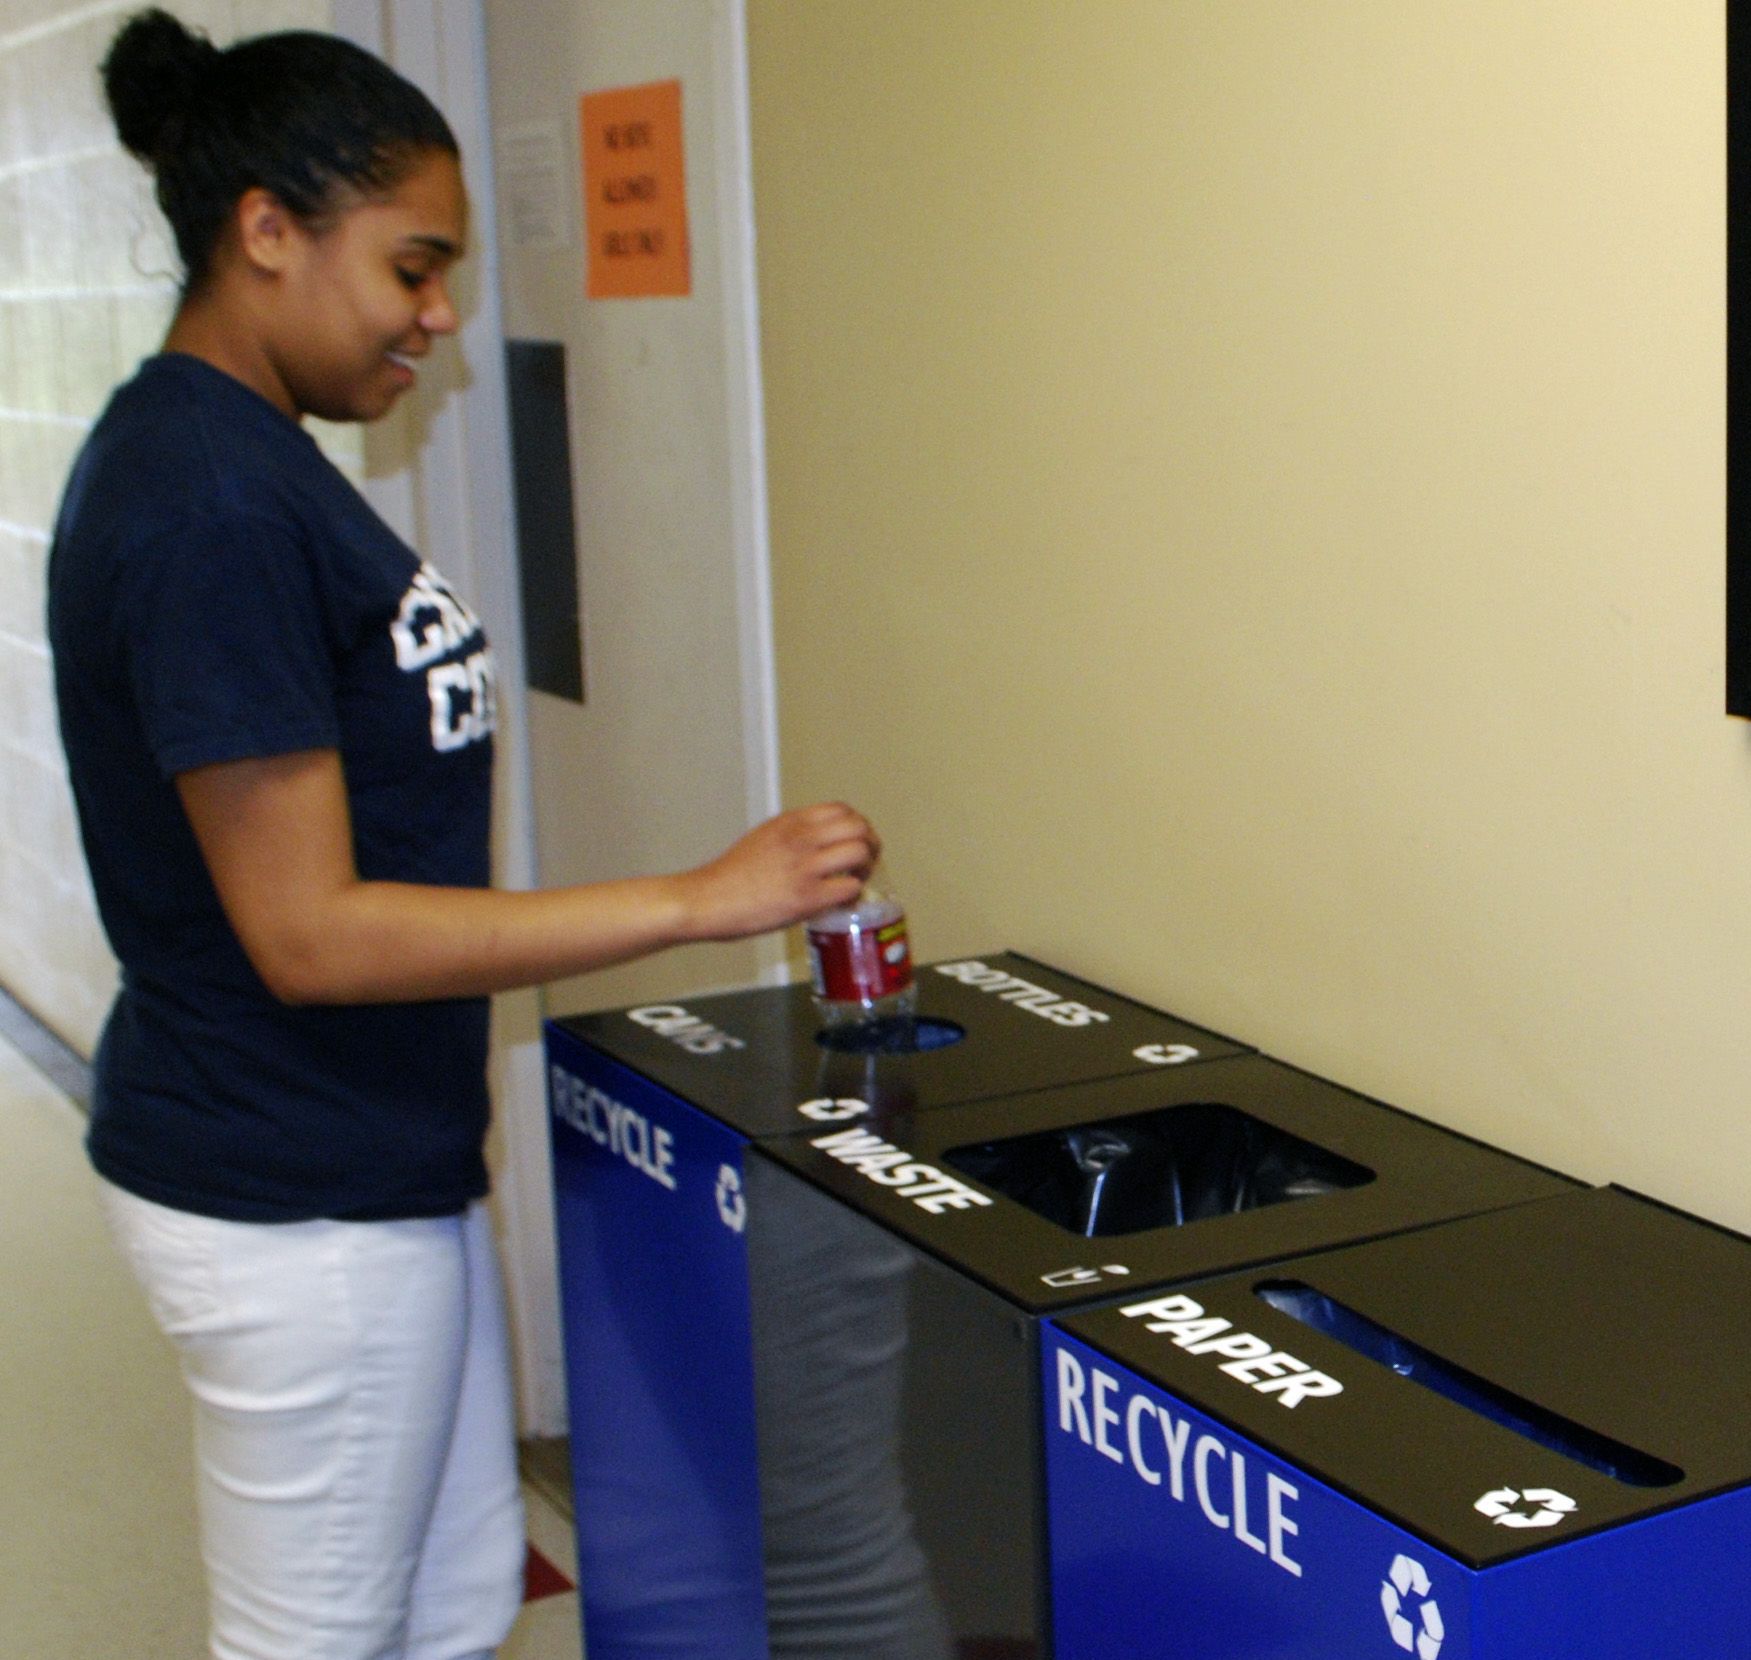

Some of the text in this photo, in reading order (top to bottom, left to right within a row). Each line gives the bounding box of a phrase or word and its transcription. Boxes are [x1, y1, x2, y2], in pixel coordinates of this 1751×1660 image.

[627, 1005, 746, 1055] CANS
[934, 960, 1110, 1027] BOTTLES
[552, 1064, 677, 1191] RECYCLE
[810, 1128, 994, 1214] WASTE
[1119, 1294, 1344, 1409] PAPER
[1056, 1347, 1302, 1578] RECYCLE
